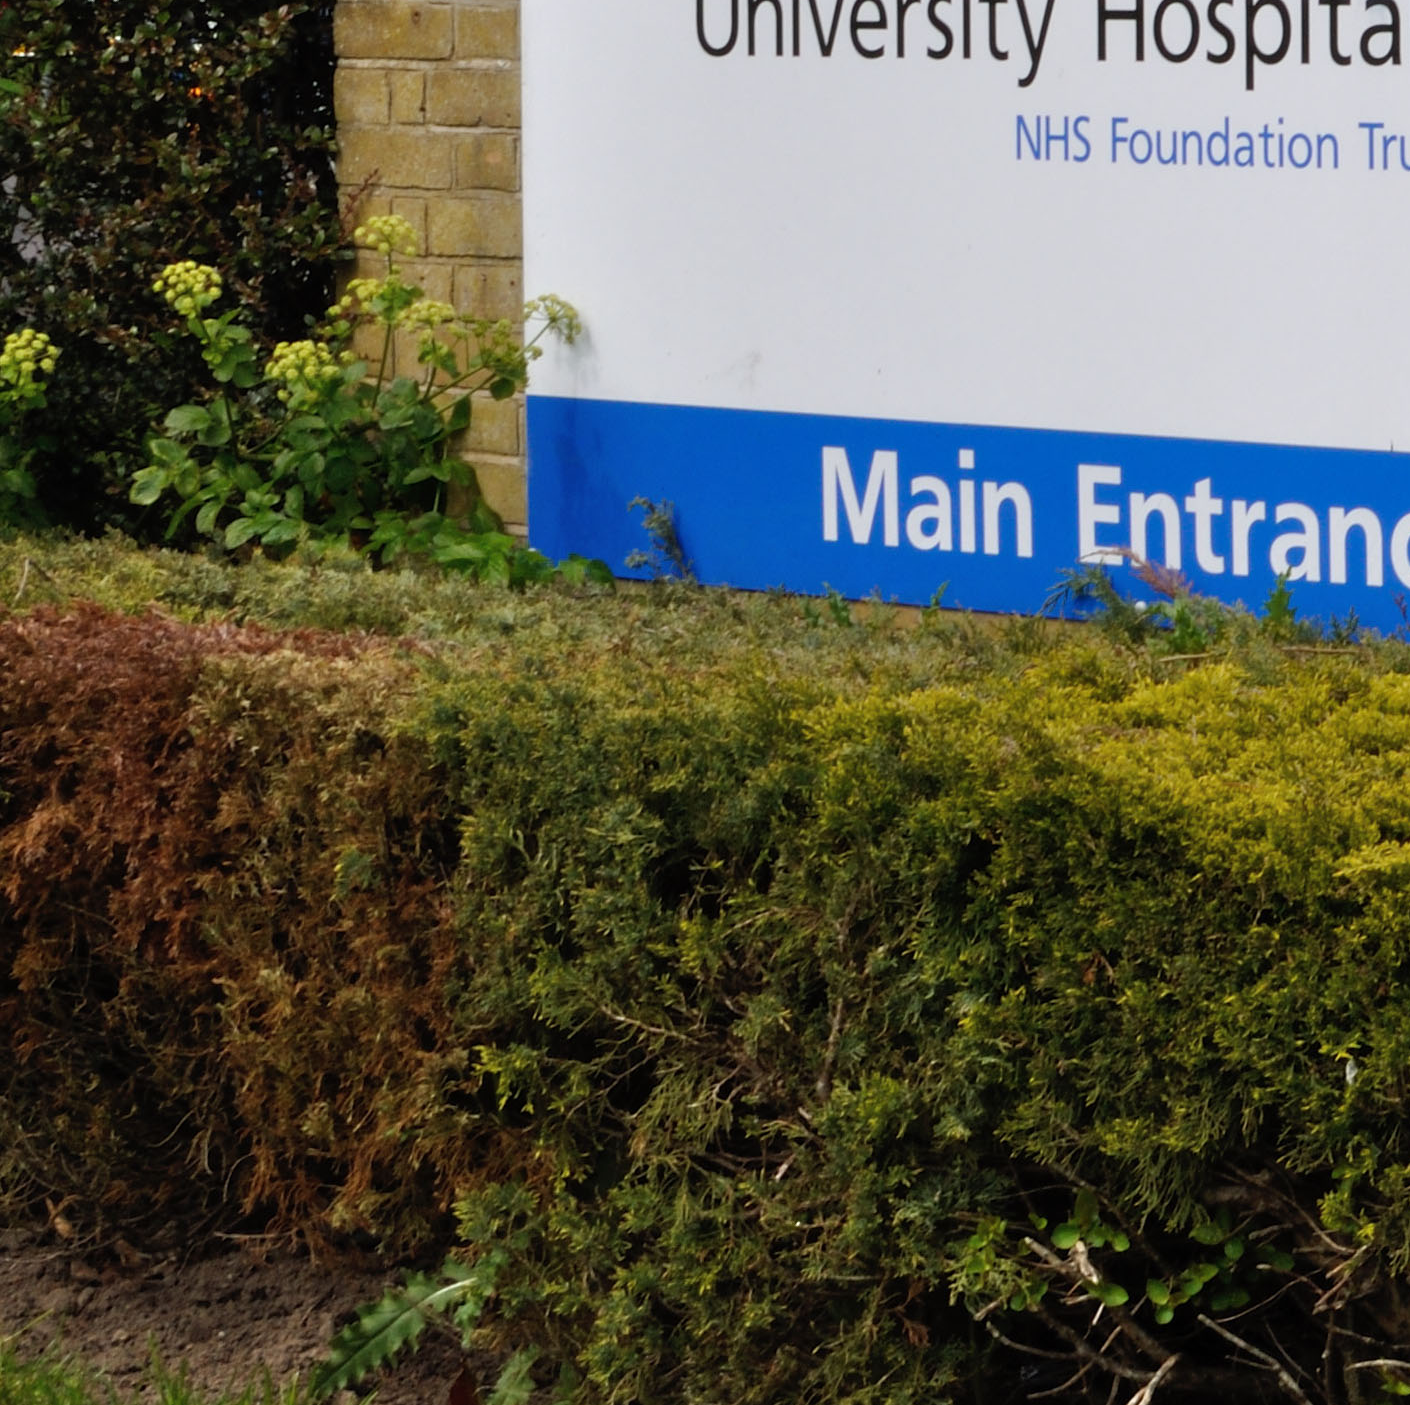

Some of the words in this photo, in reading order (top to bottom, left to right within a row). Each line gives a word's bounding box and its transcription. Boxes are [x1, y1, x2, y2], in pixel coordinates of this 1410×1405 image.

[1016, 115, 1091, 162] NHS
[1112, 118, 1338, 169] Foundation
[822, 446, 1033, 558] Main
